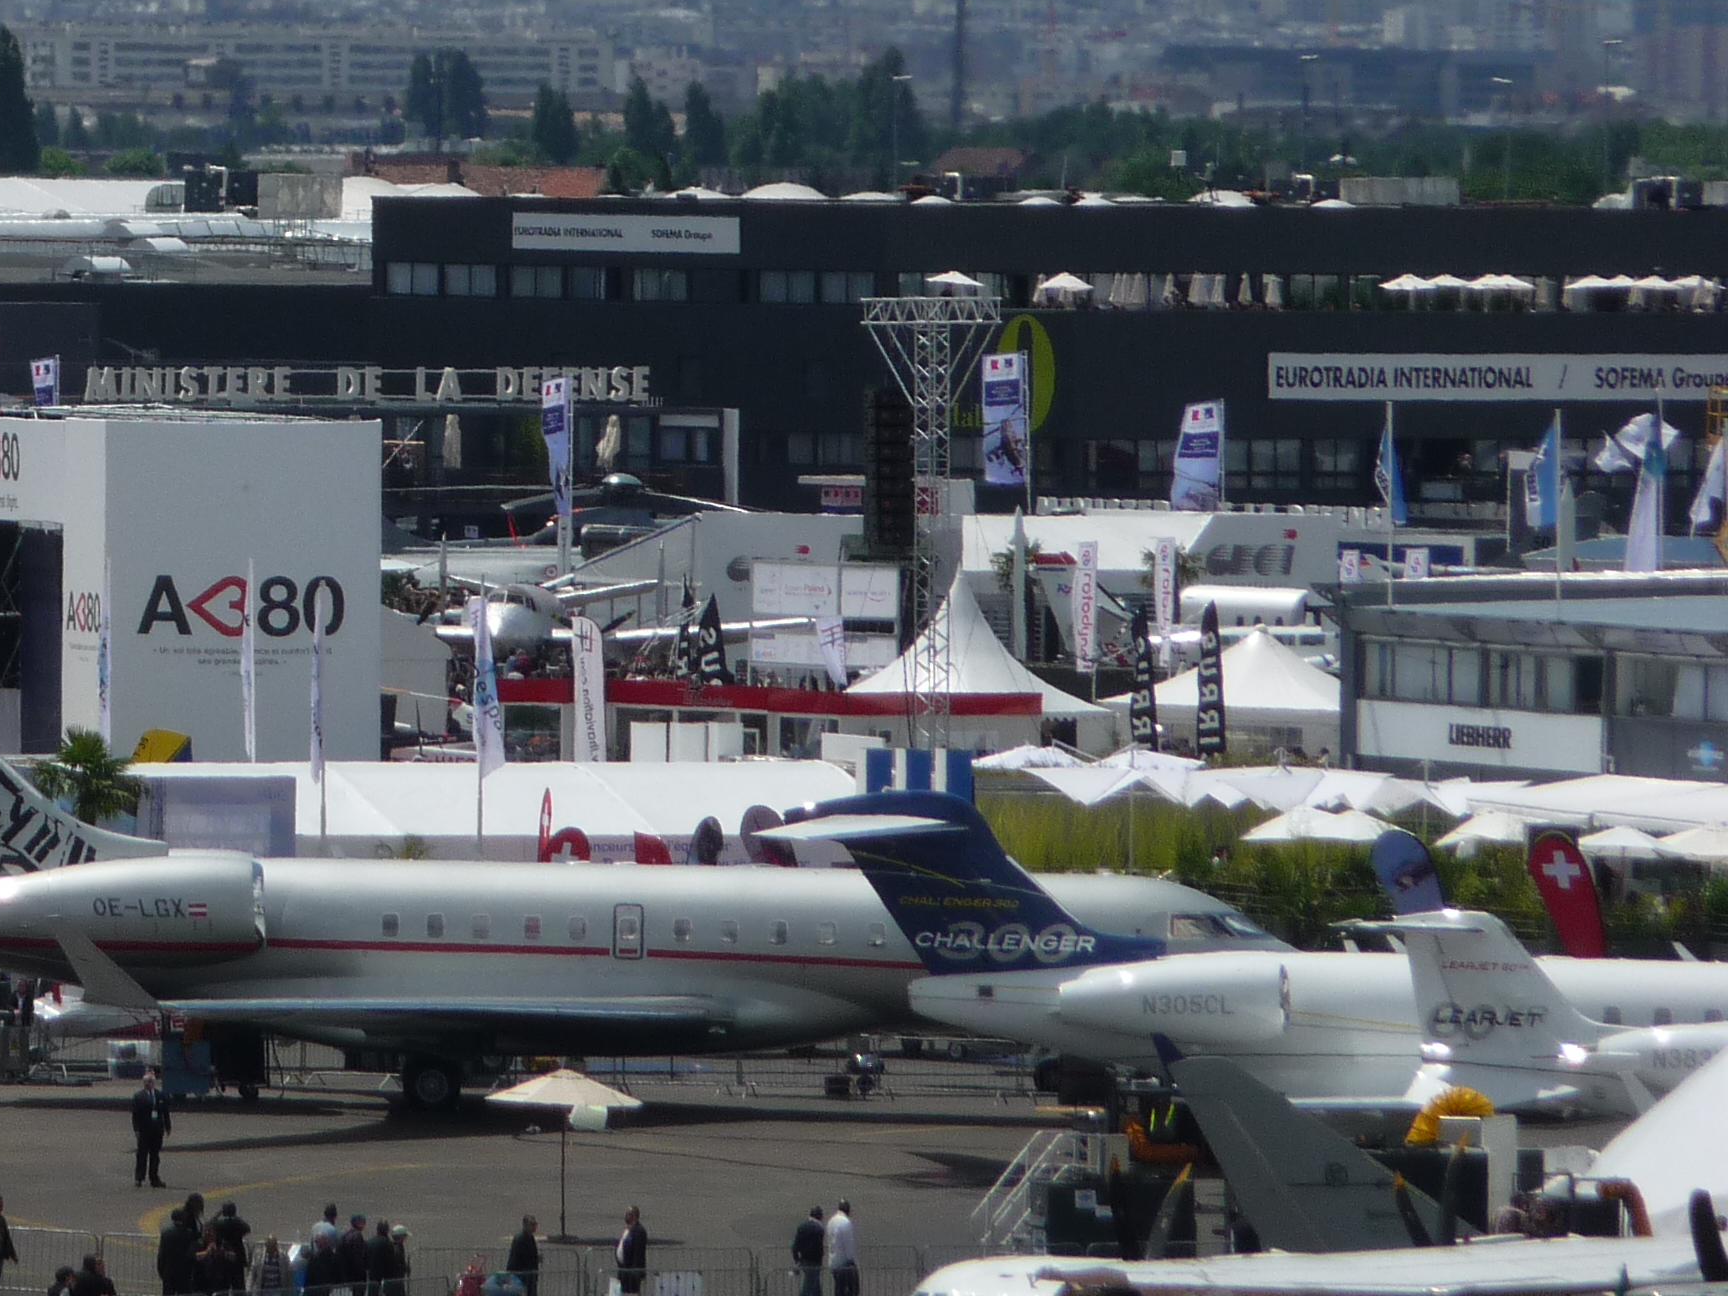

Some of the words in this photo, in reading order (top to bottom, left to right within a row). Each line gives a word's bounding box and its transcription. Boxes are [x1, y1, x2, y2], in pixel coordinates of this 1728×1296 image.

[563, 228, 624, 239] INTERNATIONAL
[652, 230, 683, 240] SOFEMA
[684, 230, 713, 242] Groupe
[84, 367, 291, 401] MINISTERE
[337, 367, 383, 401] DE
[414, 367, 462, 401] LA
[1275, 366, 1388, 389] EUROTRADIA
[1393, 366, 1534, 390] INTERNATIONAL
[1594, 367, 1666, 390] SOFEMA
[1448, 723, 1512, 749] LIEBHERR
[93, 897, 186, 920] OE-LGX
[915, 930, 1097, 953] CHALLENGER
[1441, 960, 1499, 972] LEARJET
[1142, 993, 1235, 1016] N305CL
[1432, 1010, 1542, 1028] LEARJET
